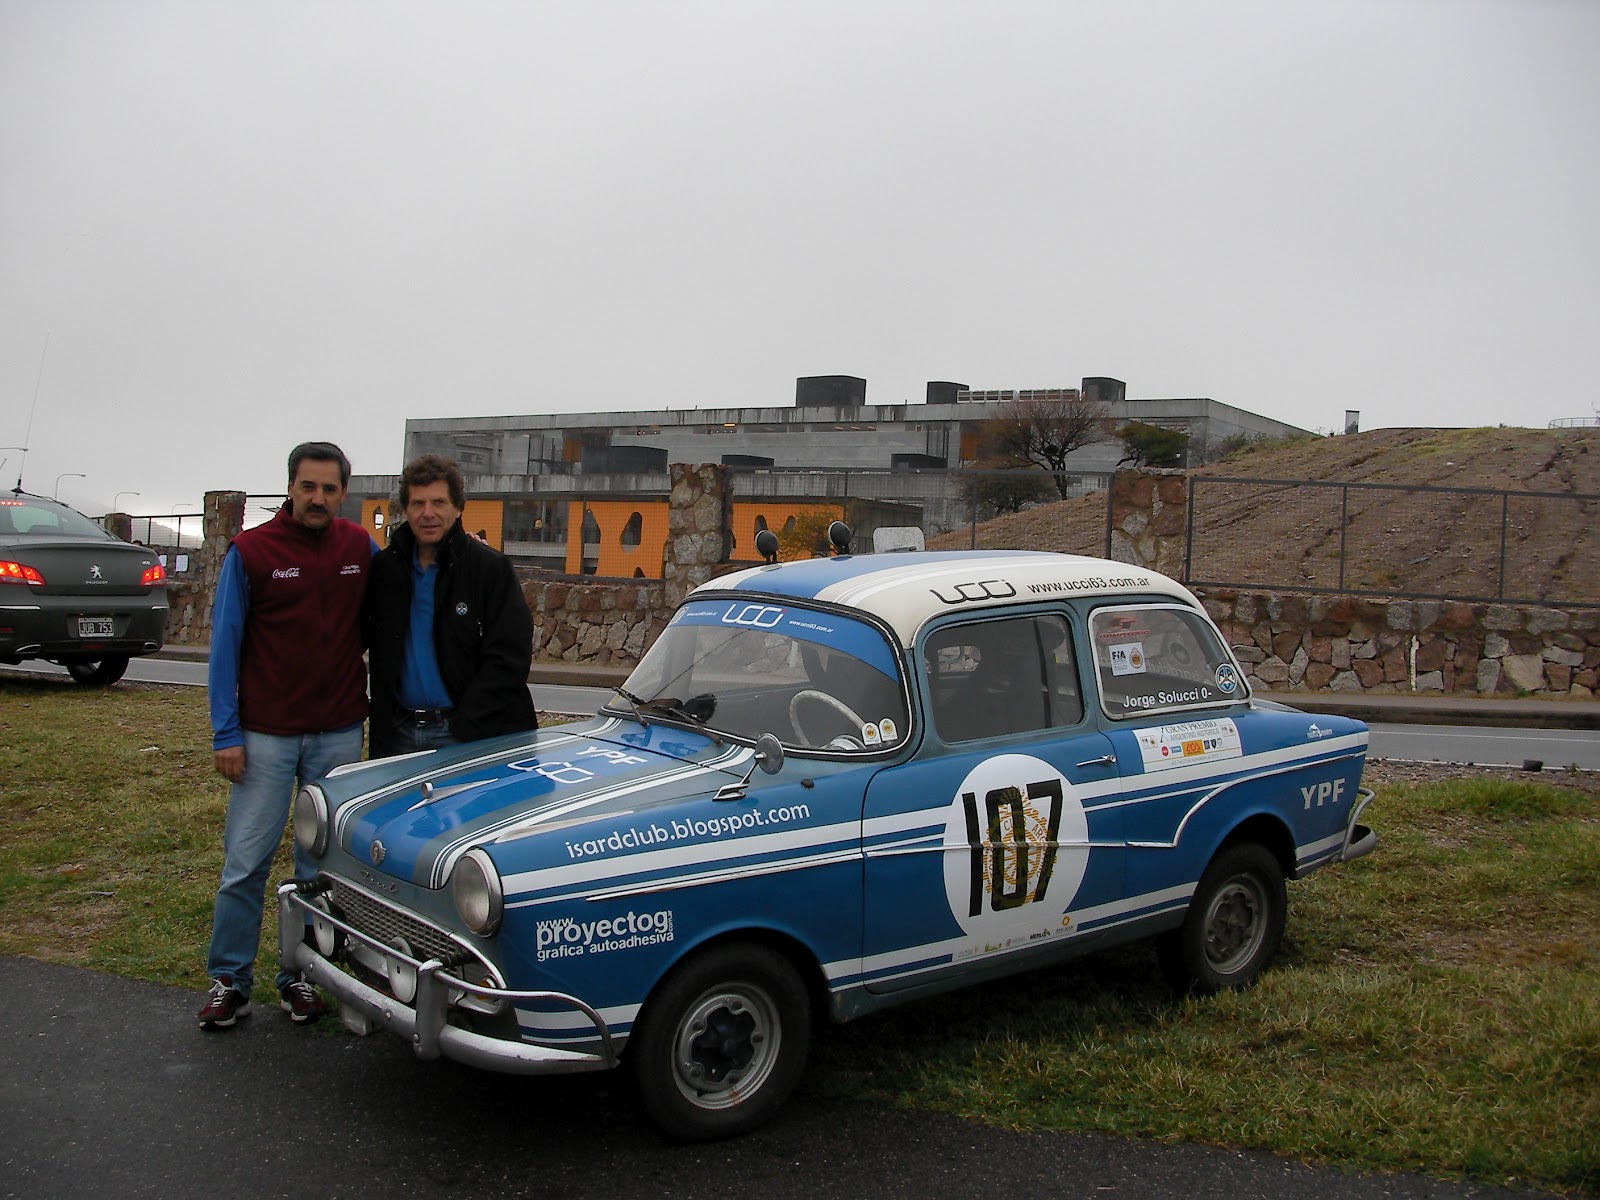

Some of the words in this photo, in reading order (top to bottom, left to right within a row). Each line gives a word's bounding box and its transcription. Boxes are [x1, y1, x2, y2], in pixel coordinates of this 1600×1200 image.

[1027, 576, 1150, 594] www.ucci63.com.ar
[81, 623, 95, 634] JUB
[98, 622, 113, 633] 753
[1123, 693, 1156, 709] Jorge
[1158, 687, 1199, 704] Solucci
[1164, 723, 1188, 734] GRAN
[1188, 720, 1217, 731] PREMIO
[576, 745, 648, 765] YPF
[1301, 778, 1345, 809] YPF
[565, 803, 811, 859] isardclub.blogspot.com
[962, 779, 1063, 917] 107
[536, 911, 669, 950] proyectog
[537, 944, 584, 962] grafica
[589, 931, 675, 954] autoadhesiva
